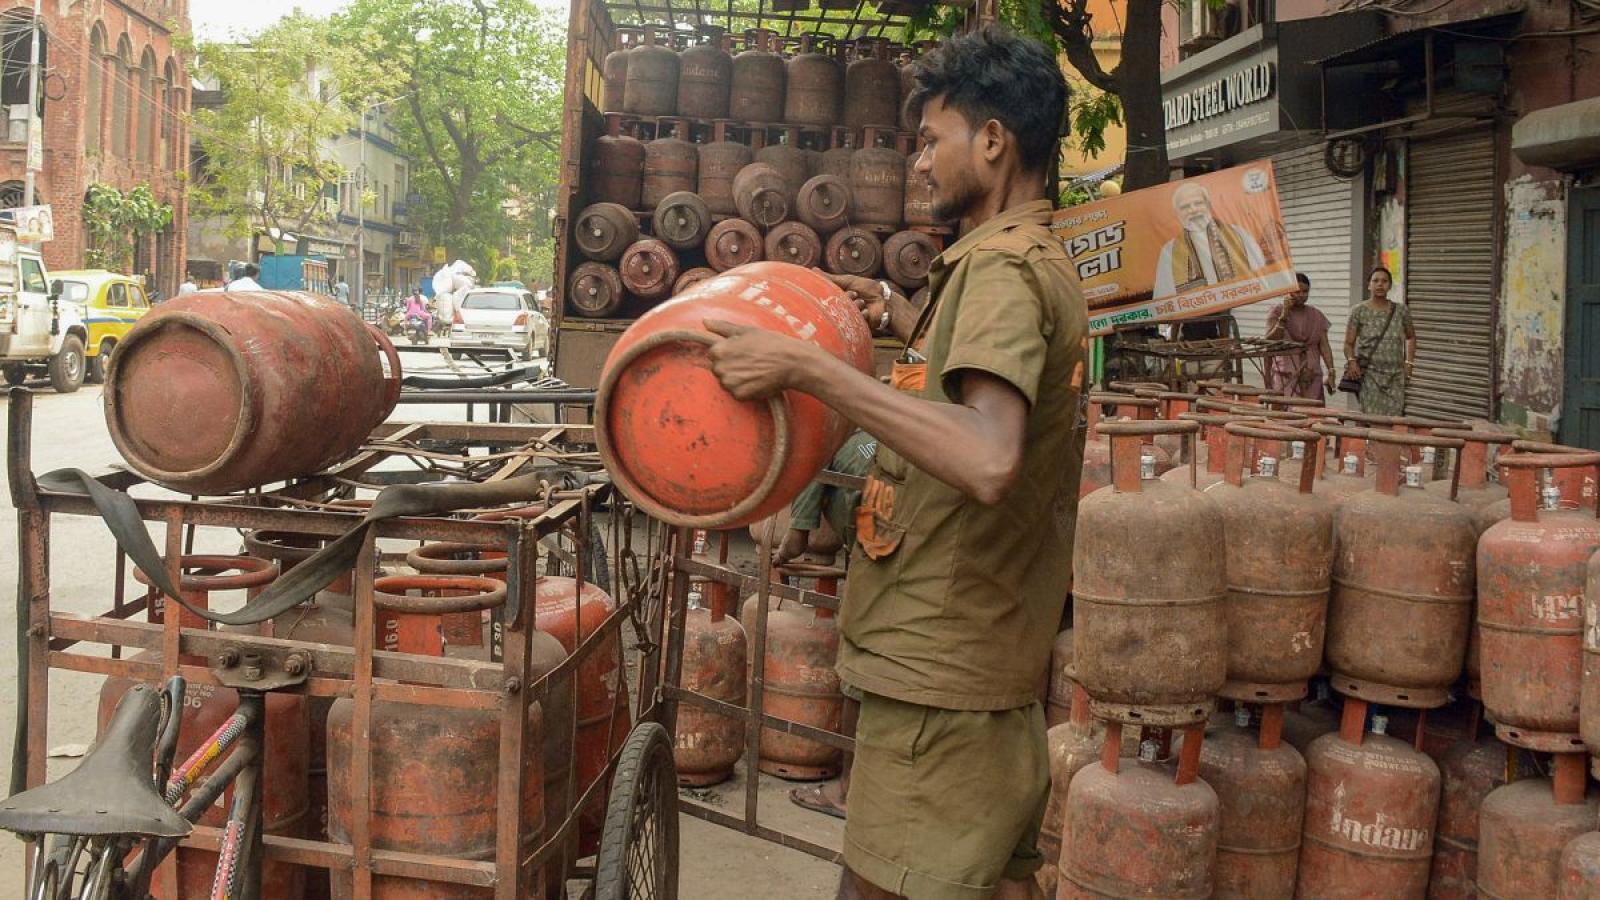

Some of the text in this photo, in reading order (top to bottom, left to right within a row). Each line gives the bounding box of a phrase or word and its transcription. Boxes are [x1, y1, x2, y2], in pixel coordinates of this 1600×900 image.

[1163, 92, 1191, 130] DARD
[1192, 79, 1225, 121] STEEL
[1226, 61, 1270, 111] WORLD
[184, 695, 202, 708] 06
